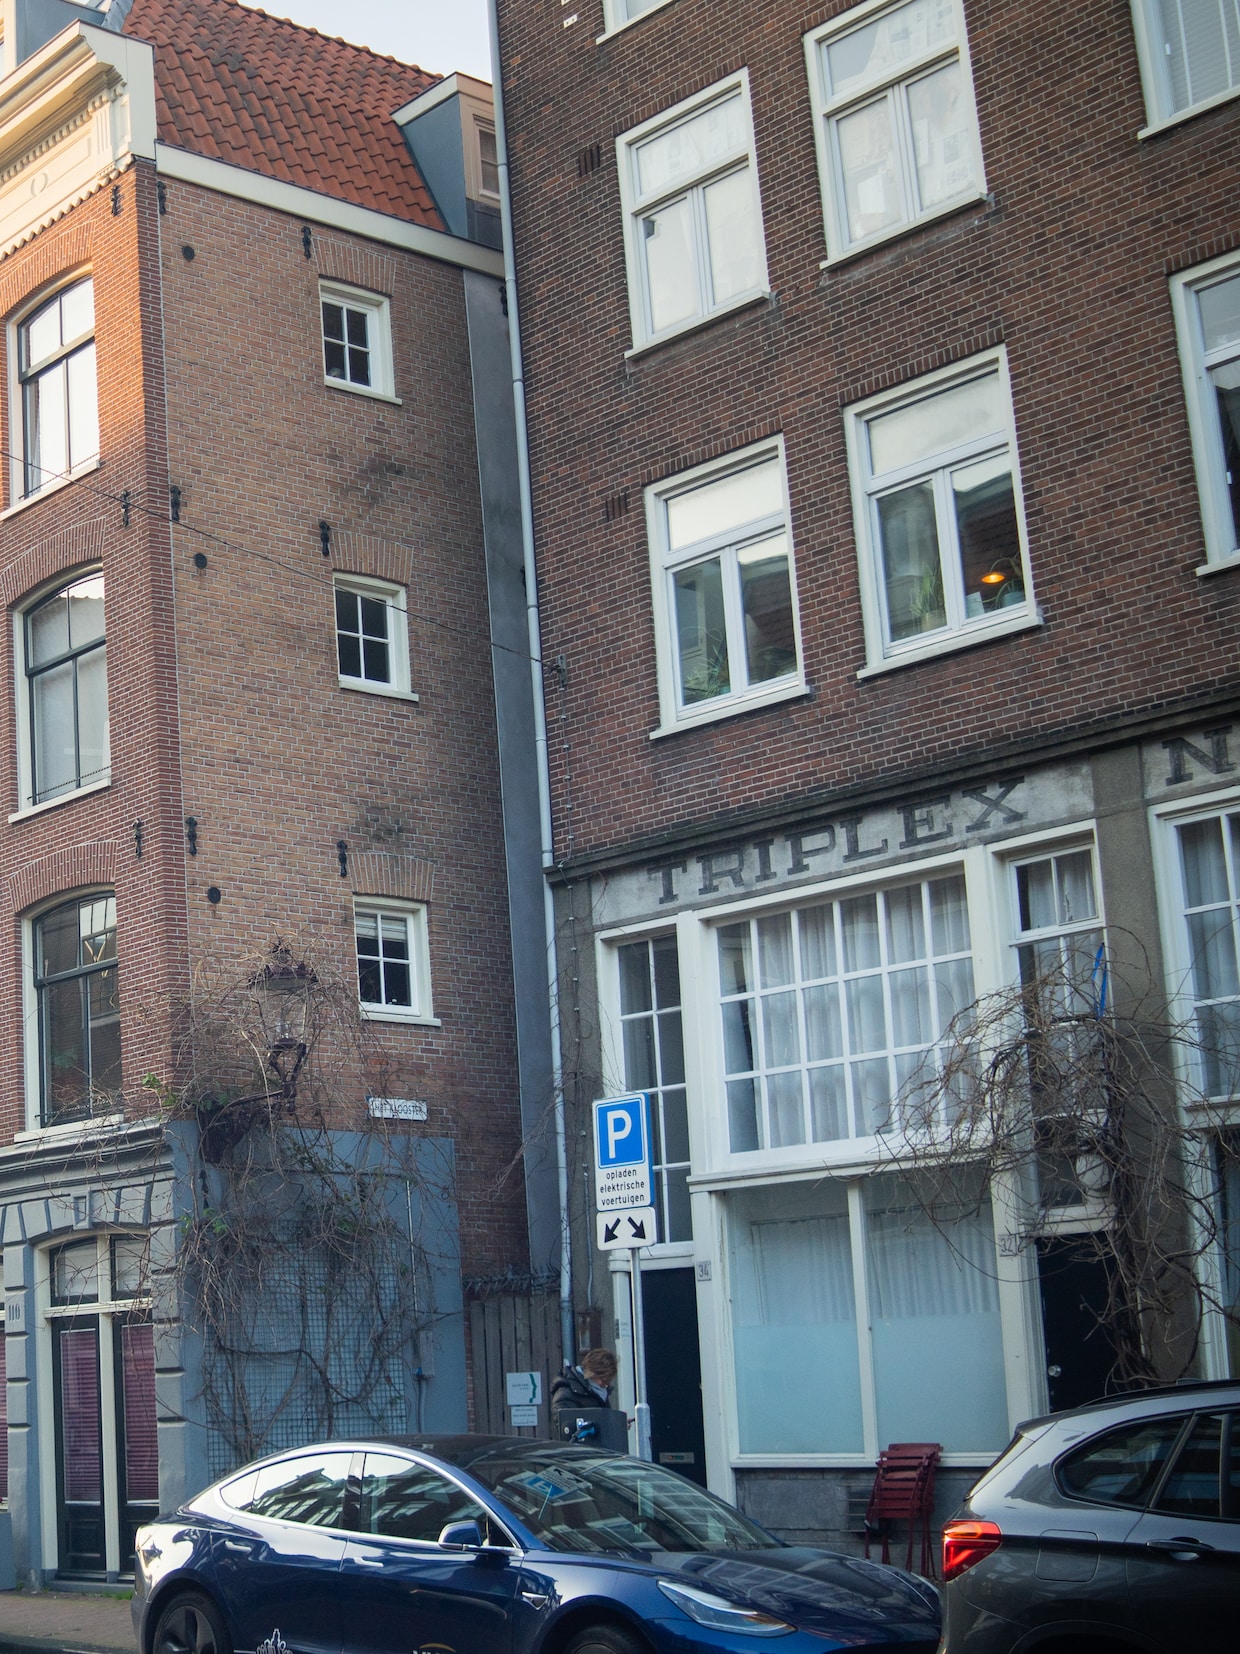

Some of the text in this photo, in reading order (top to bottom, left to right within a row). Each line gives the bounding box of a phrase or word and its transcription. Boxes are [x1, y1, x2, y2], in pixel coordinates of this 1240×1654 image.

[647, 776, 1029, 905] TRIPLEX
[607, 1109, 632, 1159] P
[606, 1169, 637, 1180] opladen
[600, 1180, 645, 1193] elektrische
[601, 1194, 645, 1206] voertuigen
[699, 1264, 709, 1278] 34
[8, 1304, 21, 1320] 110
